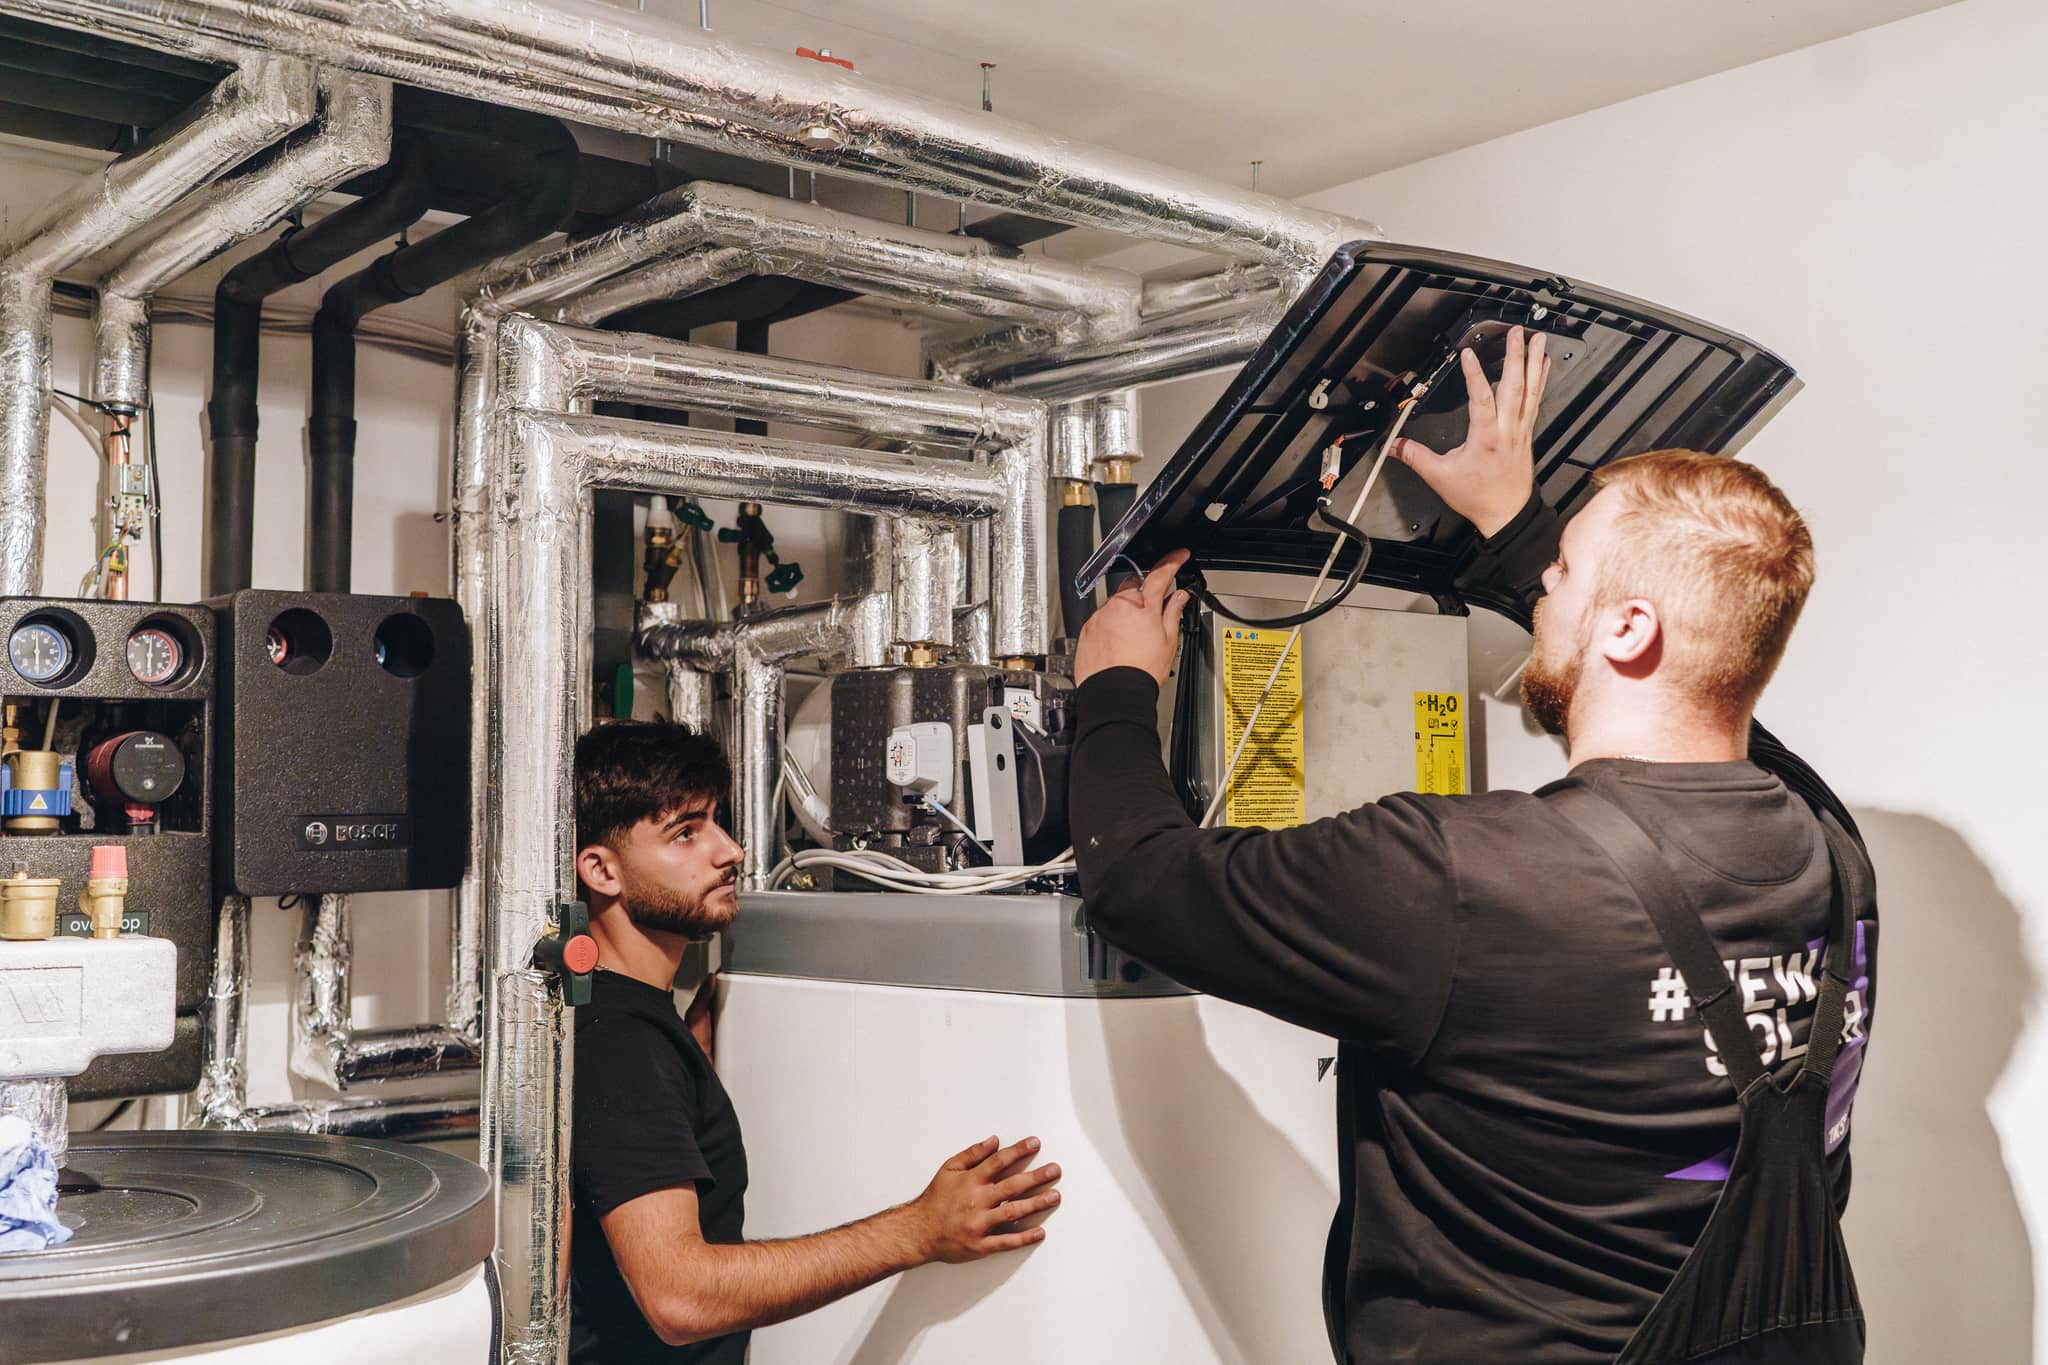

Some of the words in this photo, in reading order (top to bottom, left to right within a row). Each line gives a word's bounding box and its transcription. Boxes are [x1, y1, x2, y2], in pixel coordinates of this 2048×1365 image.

[335, 823, 399, 842] BOSCH
[70, 917, 140, 933] ovop
[1648, 948, 1818, 1022] #EW
[1703, 990, 1864, 1077] OLR
